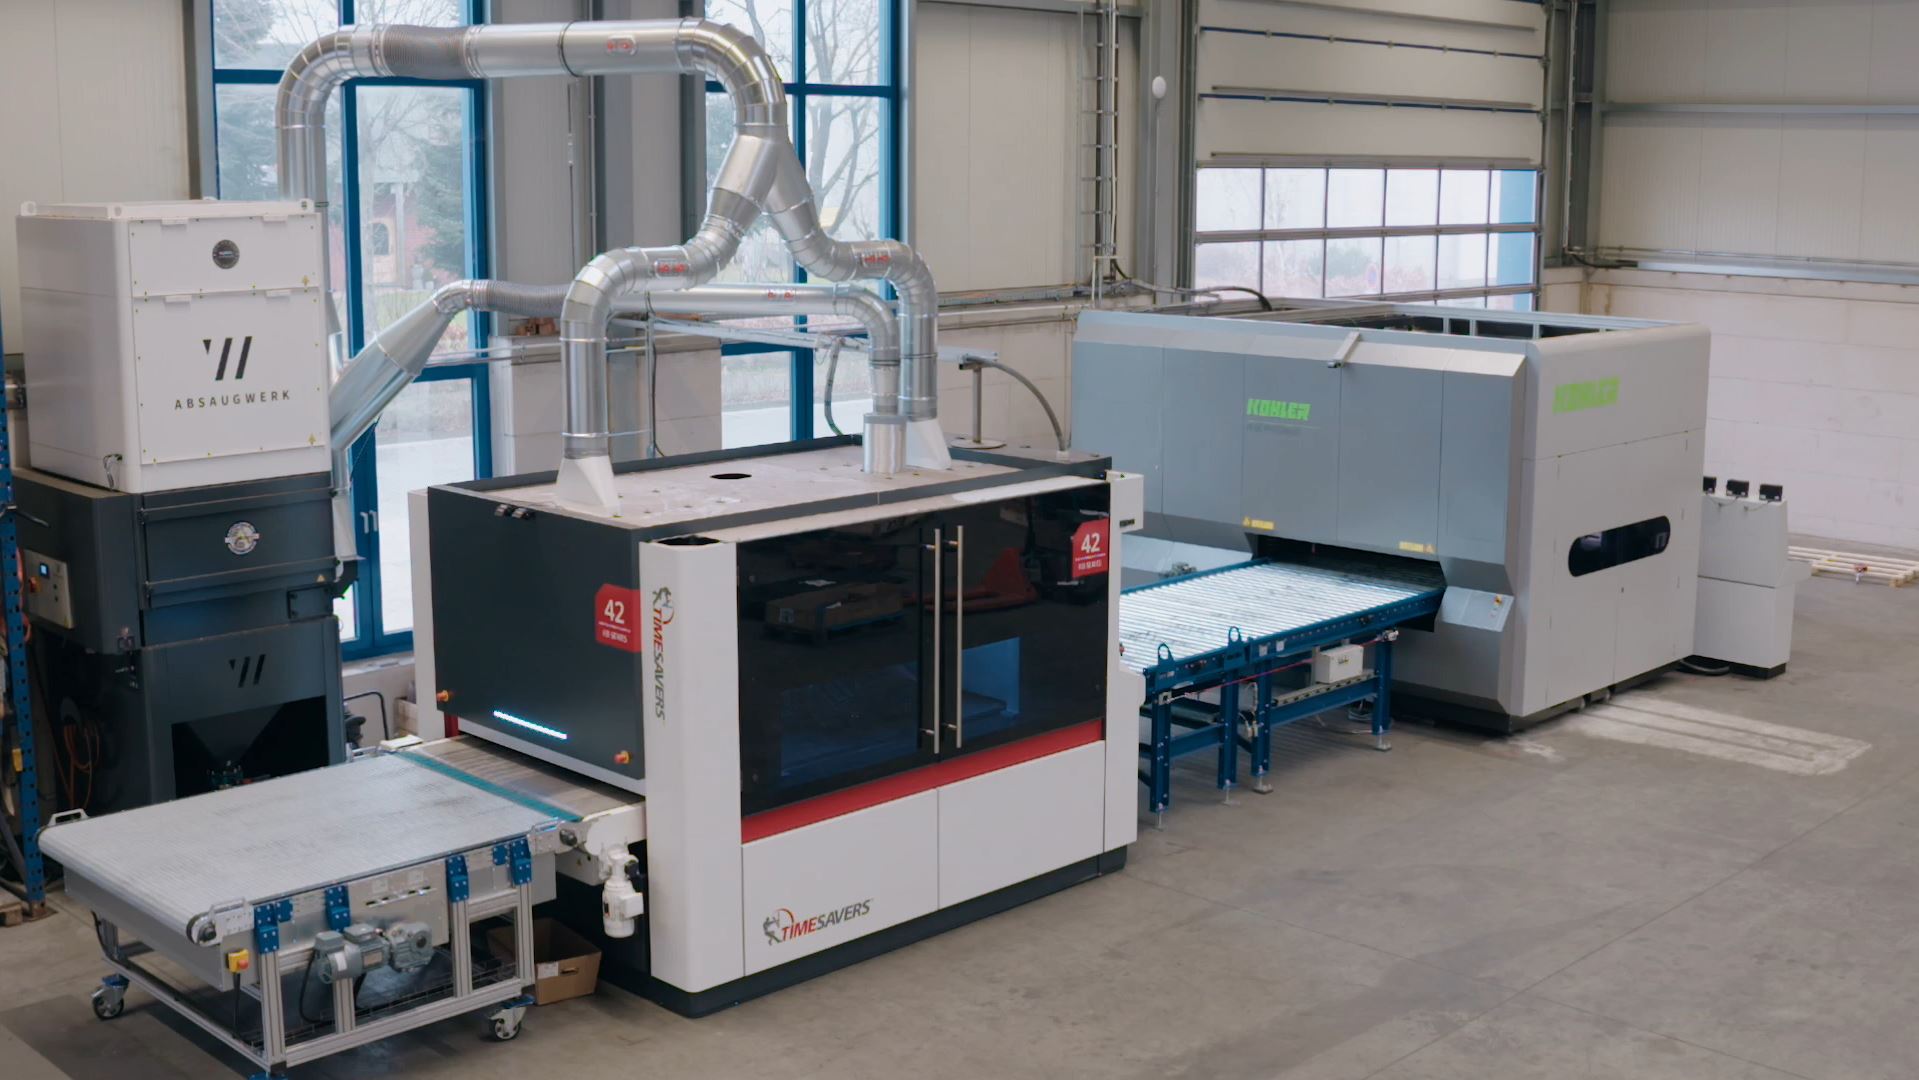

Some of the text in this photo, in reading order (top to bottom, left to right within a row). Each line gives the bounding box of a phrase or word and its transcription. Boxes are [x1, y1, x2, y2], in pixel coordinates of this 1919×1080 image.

[174, 389, 290, 410] ABSAUGWERK
[1081, 532, 1101, 553] 42
[604, 599, 625, 624] 42
[652, 607, 666, 720] TIMESAVERS
[781, 899, 873, 942] TIMESAVERS
